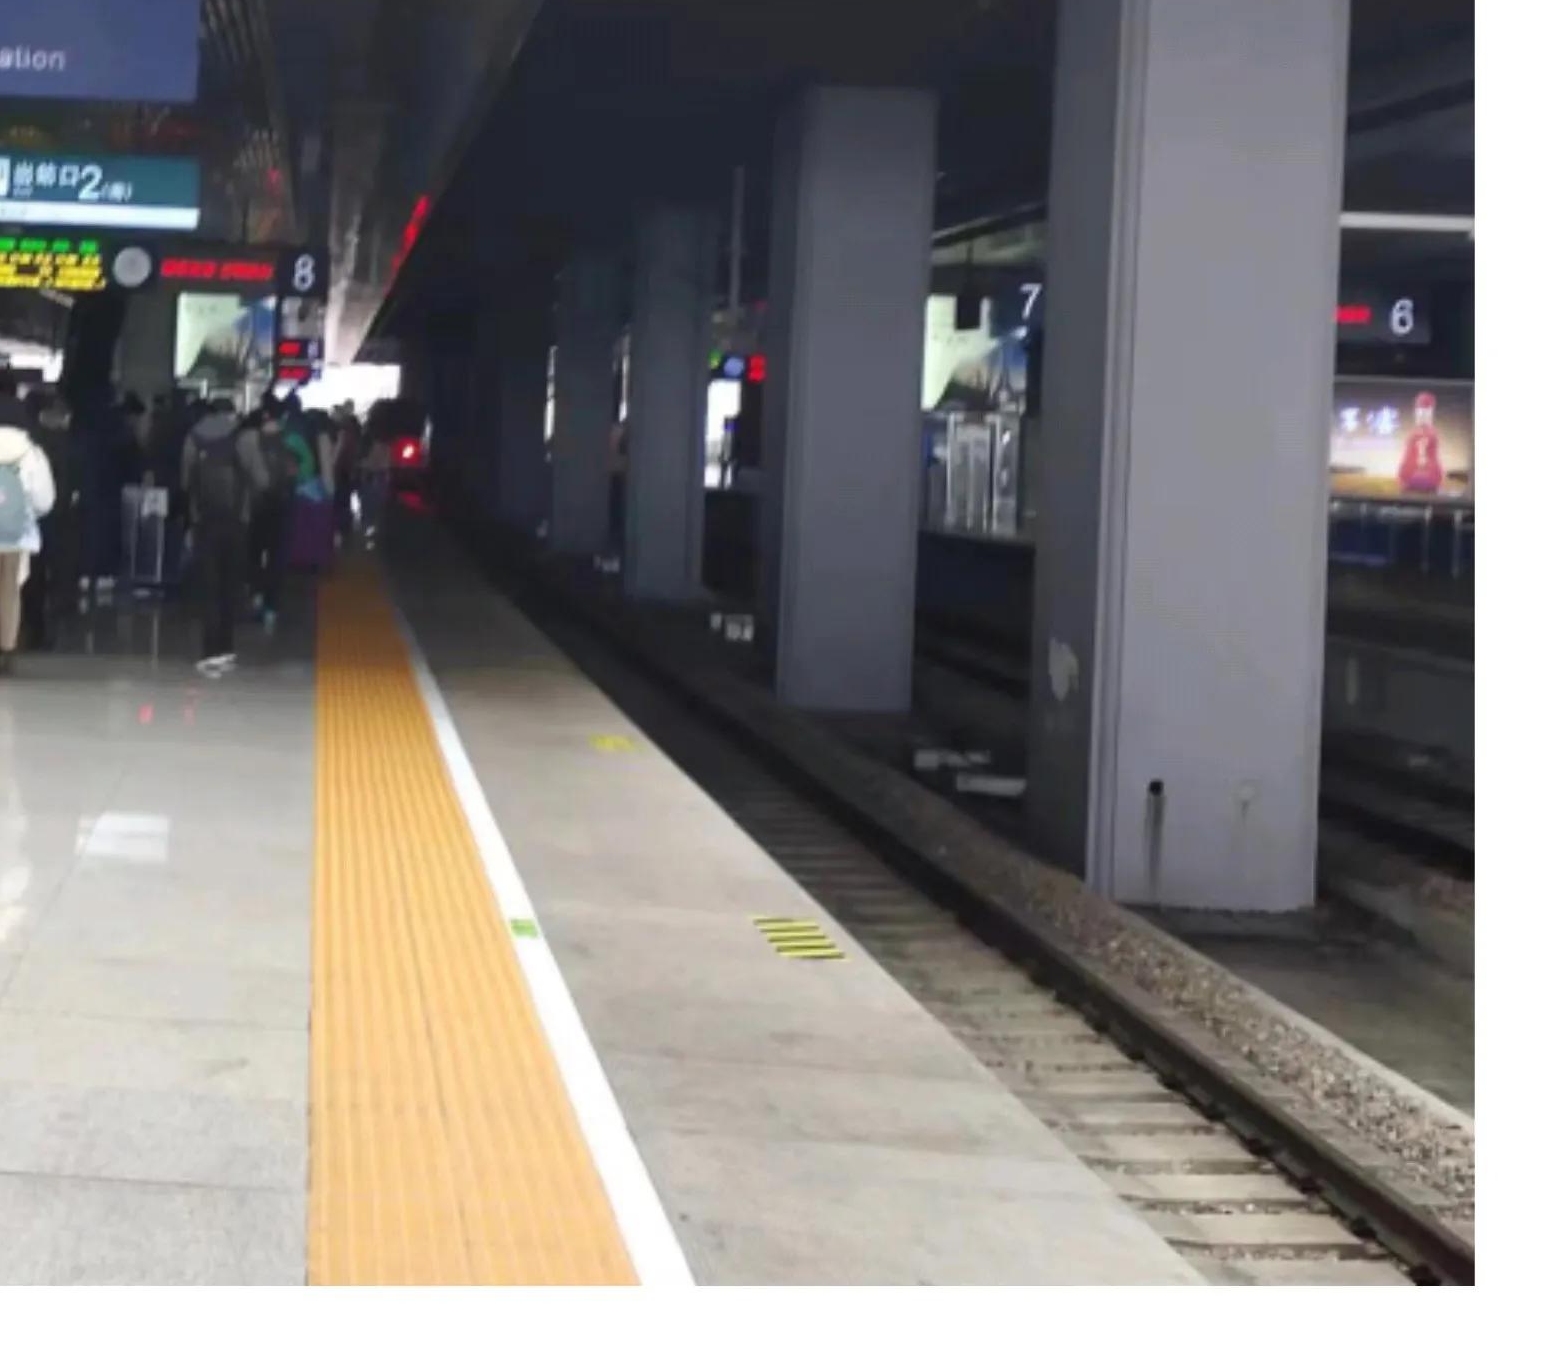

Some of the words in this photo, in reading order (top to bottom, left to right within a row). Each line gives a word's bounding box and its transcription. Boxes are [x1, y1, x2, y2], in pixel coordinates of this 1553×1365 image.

[293, 254, 315, 291] 8
[1020, 283, 1042, 319] 7
[1390, 298, 1414, 335] 6
